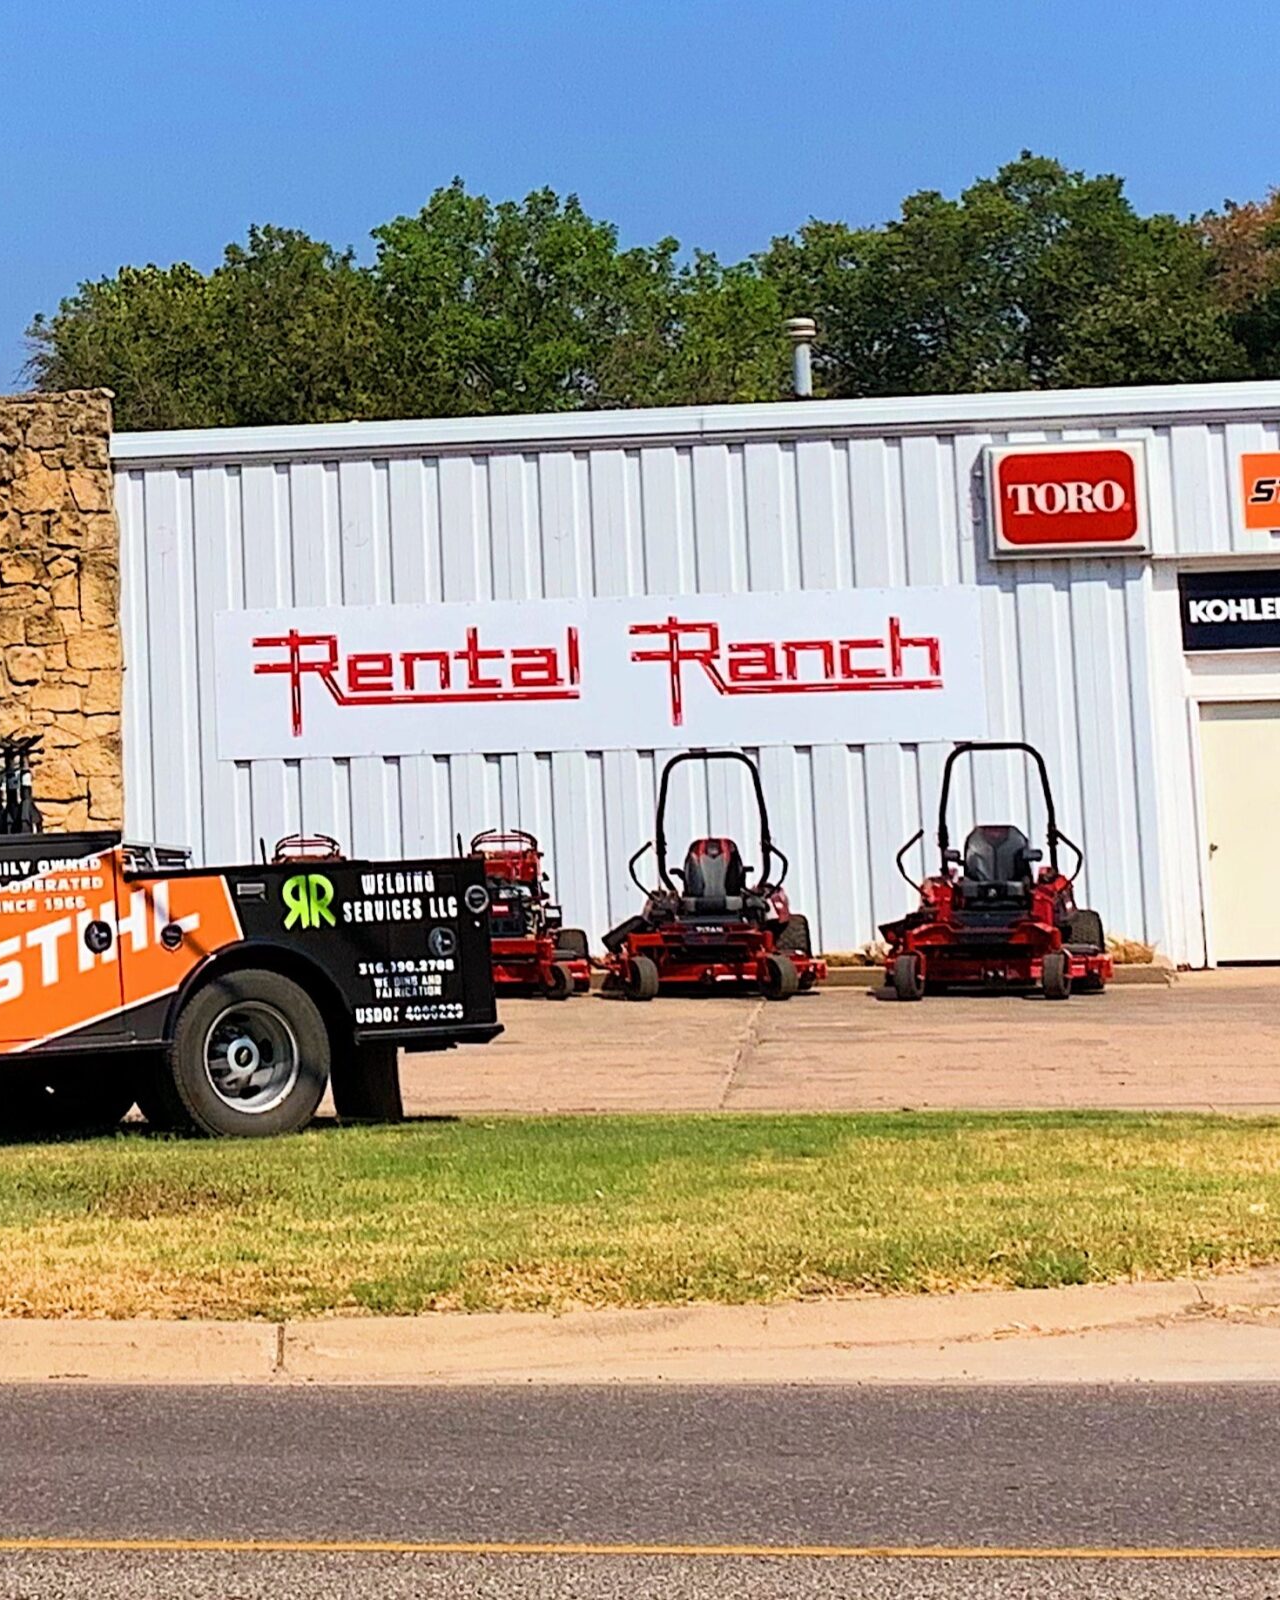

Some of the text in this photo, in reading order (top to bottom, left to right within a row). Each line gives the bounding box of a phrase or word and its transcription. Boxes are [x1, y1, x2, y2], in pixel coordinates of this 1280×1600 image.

[252, 615, 945, 738] Rental Ranch
[37, 857, 102, 874] OWNED
[7, 876, 104, 894] OPERATED
[361, 871, 436, 896] WELDING
[342, 896, 459, 923] SERVICES LLC
[373, 975, 419, 988] WEDING
